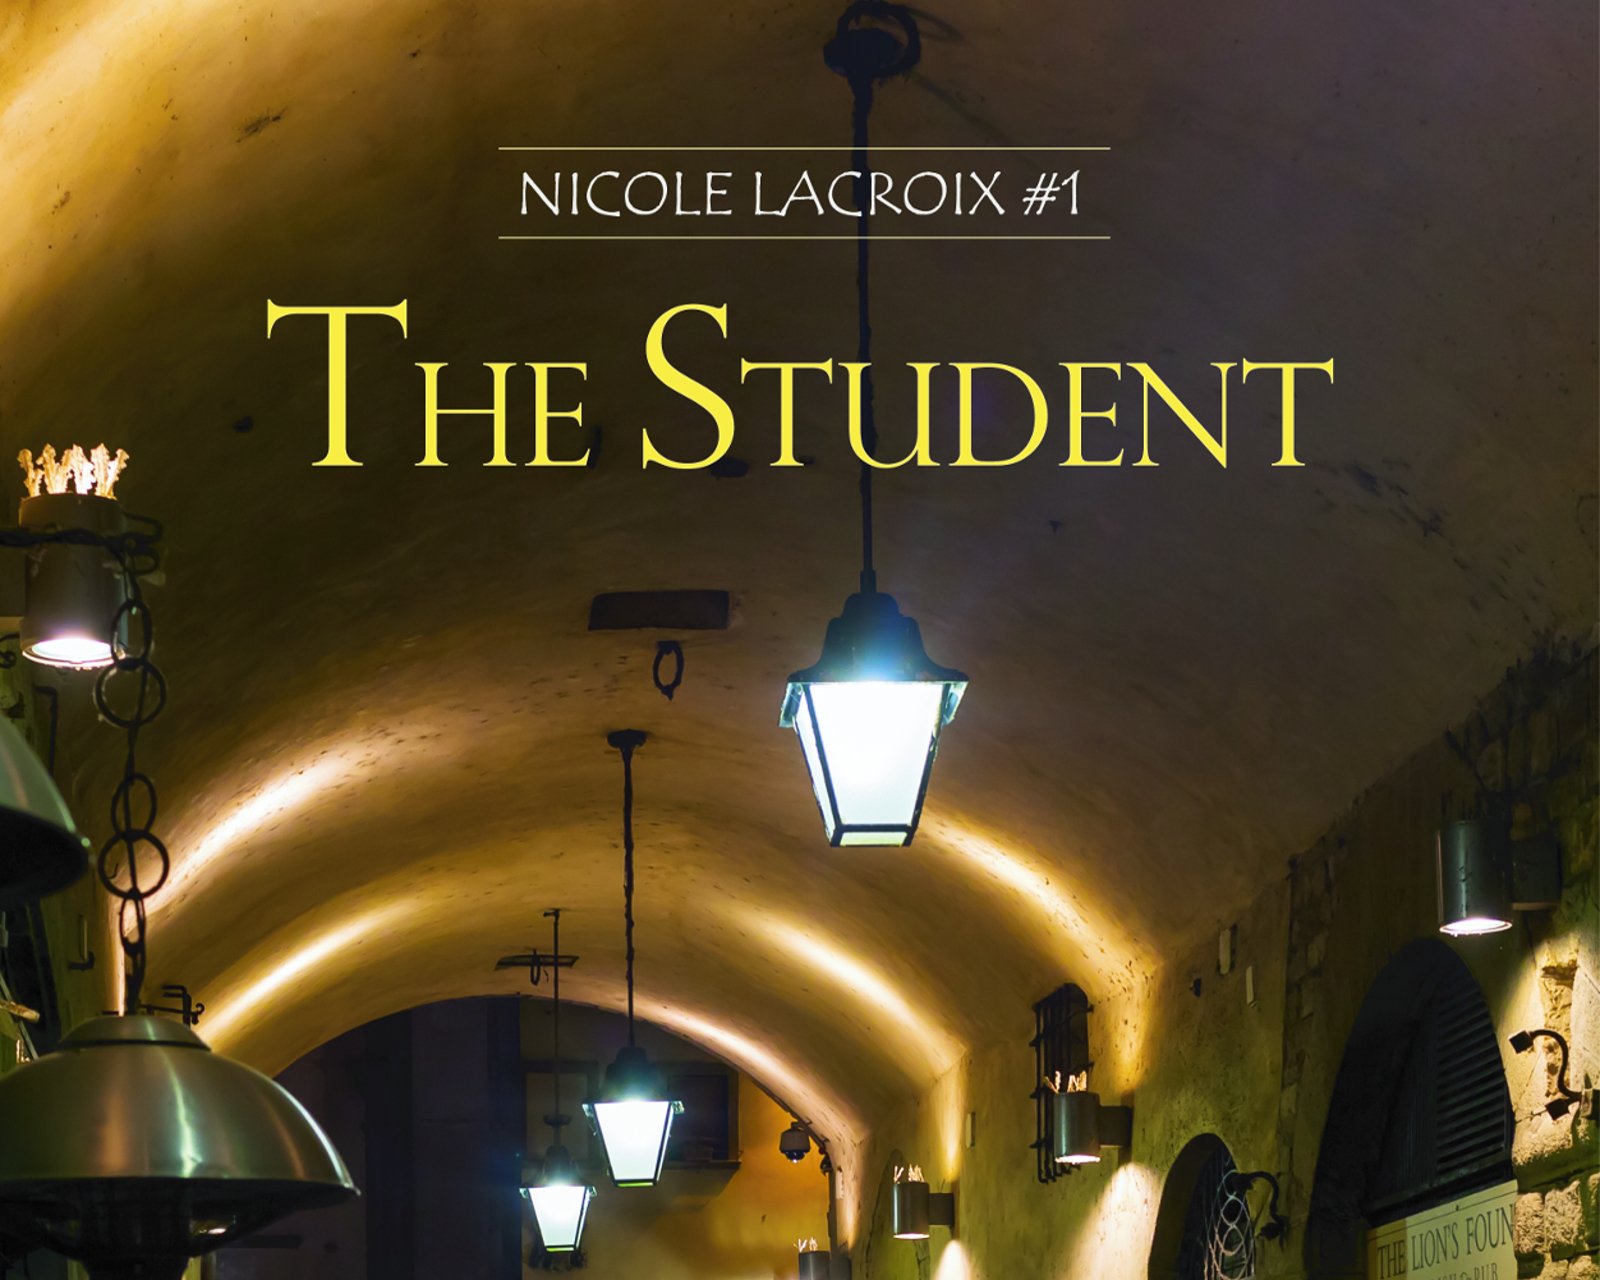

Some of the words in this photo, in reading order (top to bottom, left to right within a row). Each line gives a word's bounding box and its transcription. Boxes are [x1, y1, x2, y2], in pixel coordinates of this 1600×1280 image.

[1377, 1239, 1407, 1280] THE
[1411, 1221, 1460, 1272] LION'S
[1465, 1203, 1514, 1256] FOUN
